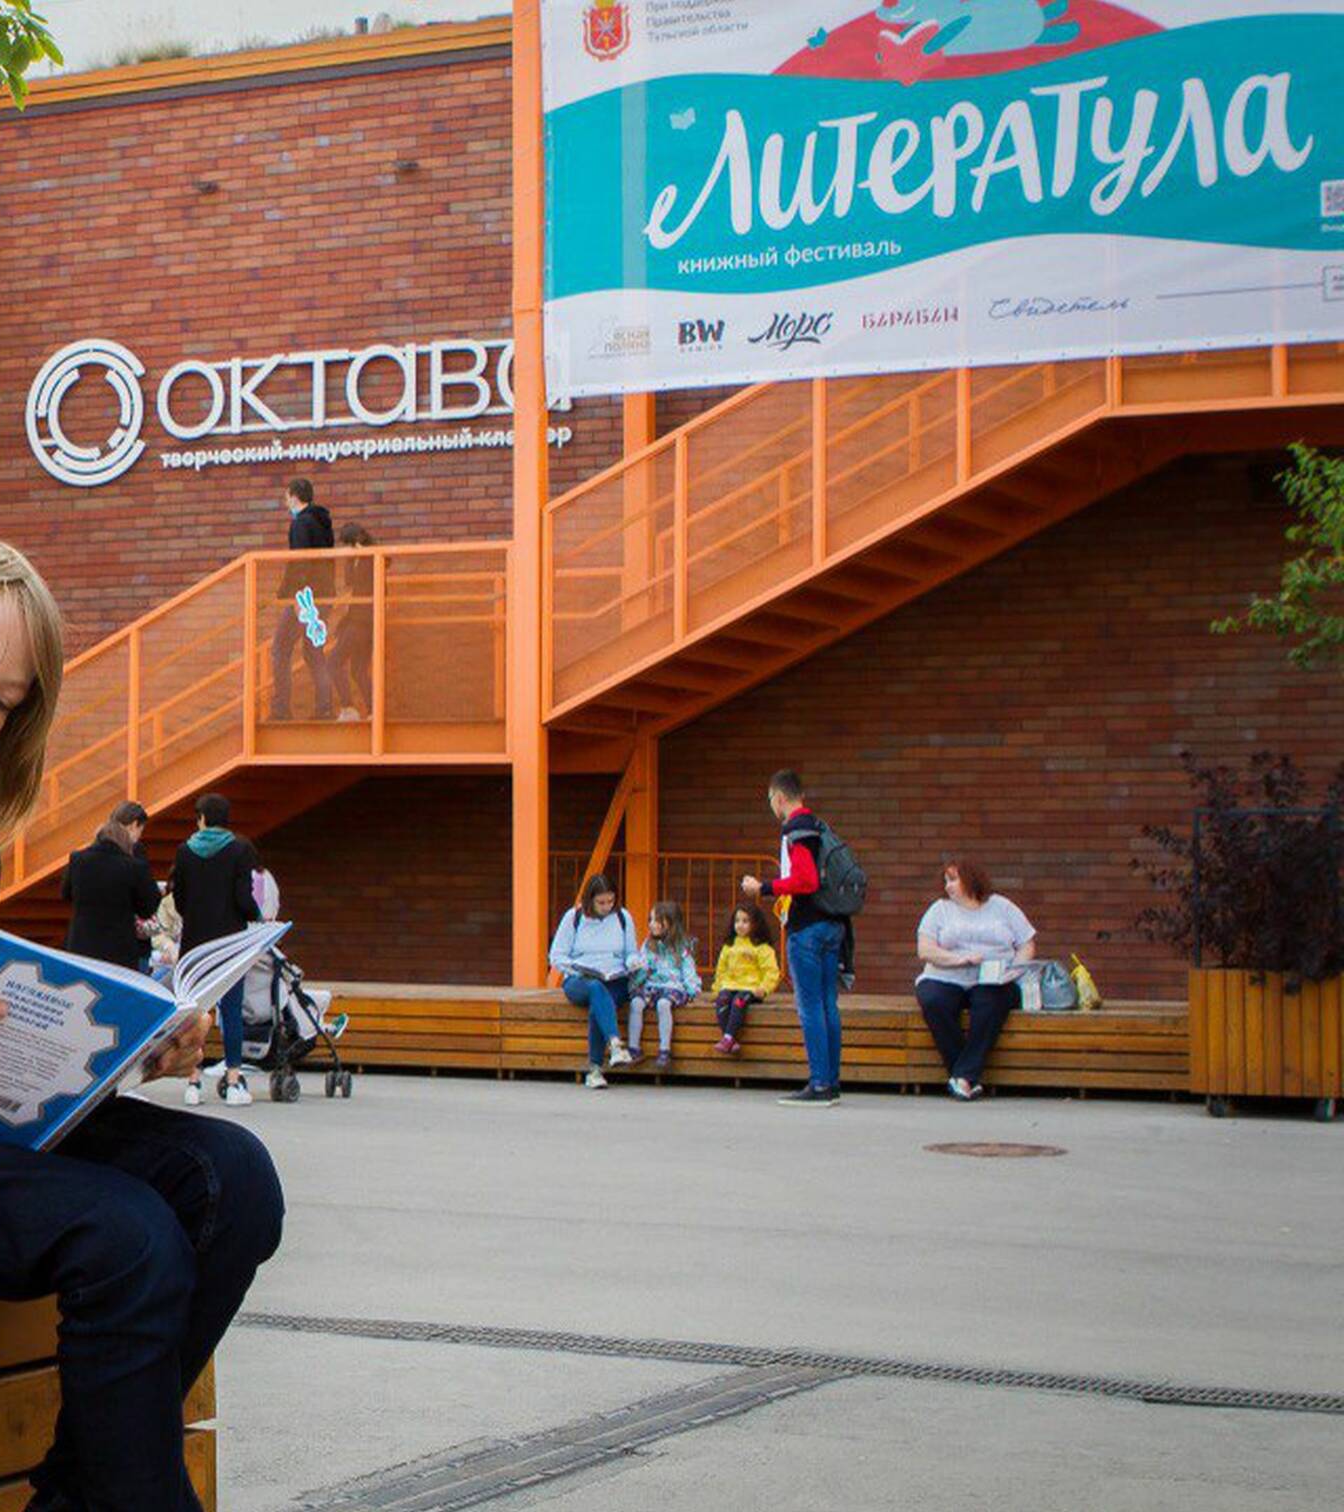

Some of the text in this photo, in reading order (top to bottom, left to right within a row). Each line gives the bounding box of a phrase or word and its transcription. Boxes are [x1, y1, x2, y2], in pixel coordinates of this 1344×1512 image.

[677, 240, 903, 274] книжный фестиваль
[678, 319, 725, 345] BW
[160, 439, 283, 471] творческий
[288, 427, 474, 463] индустриальный
